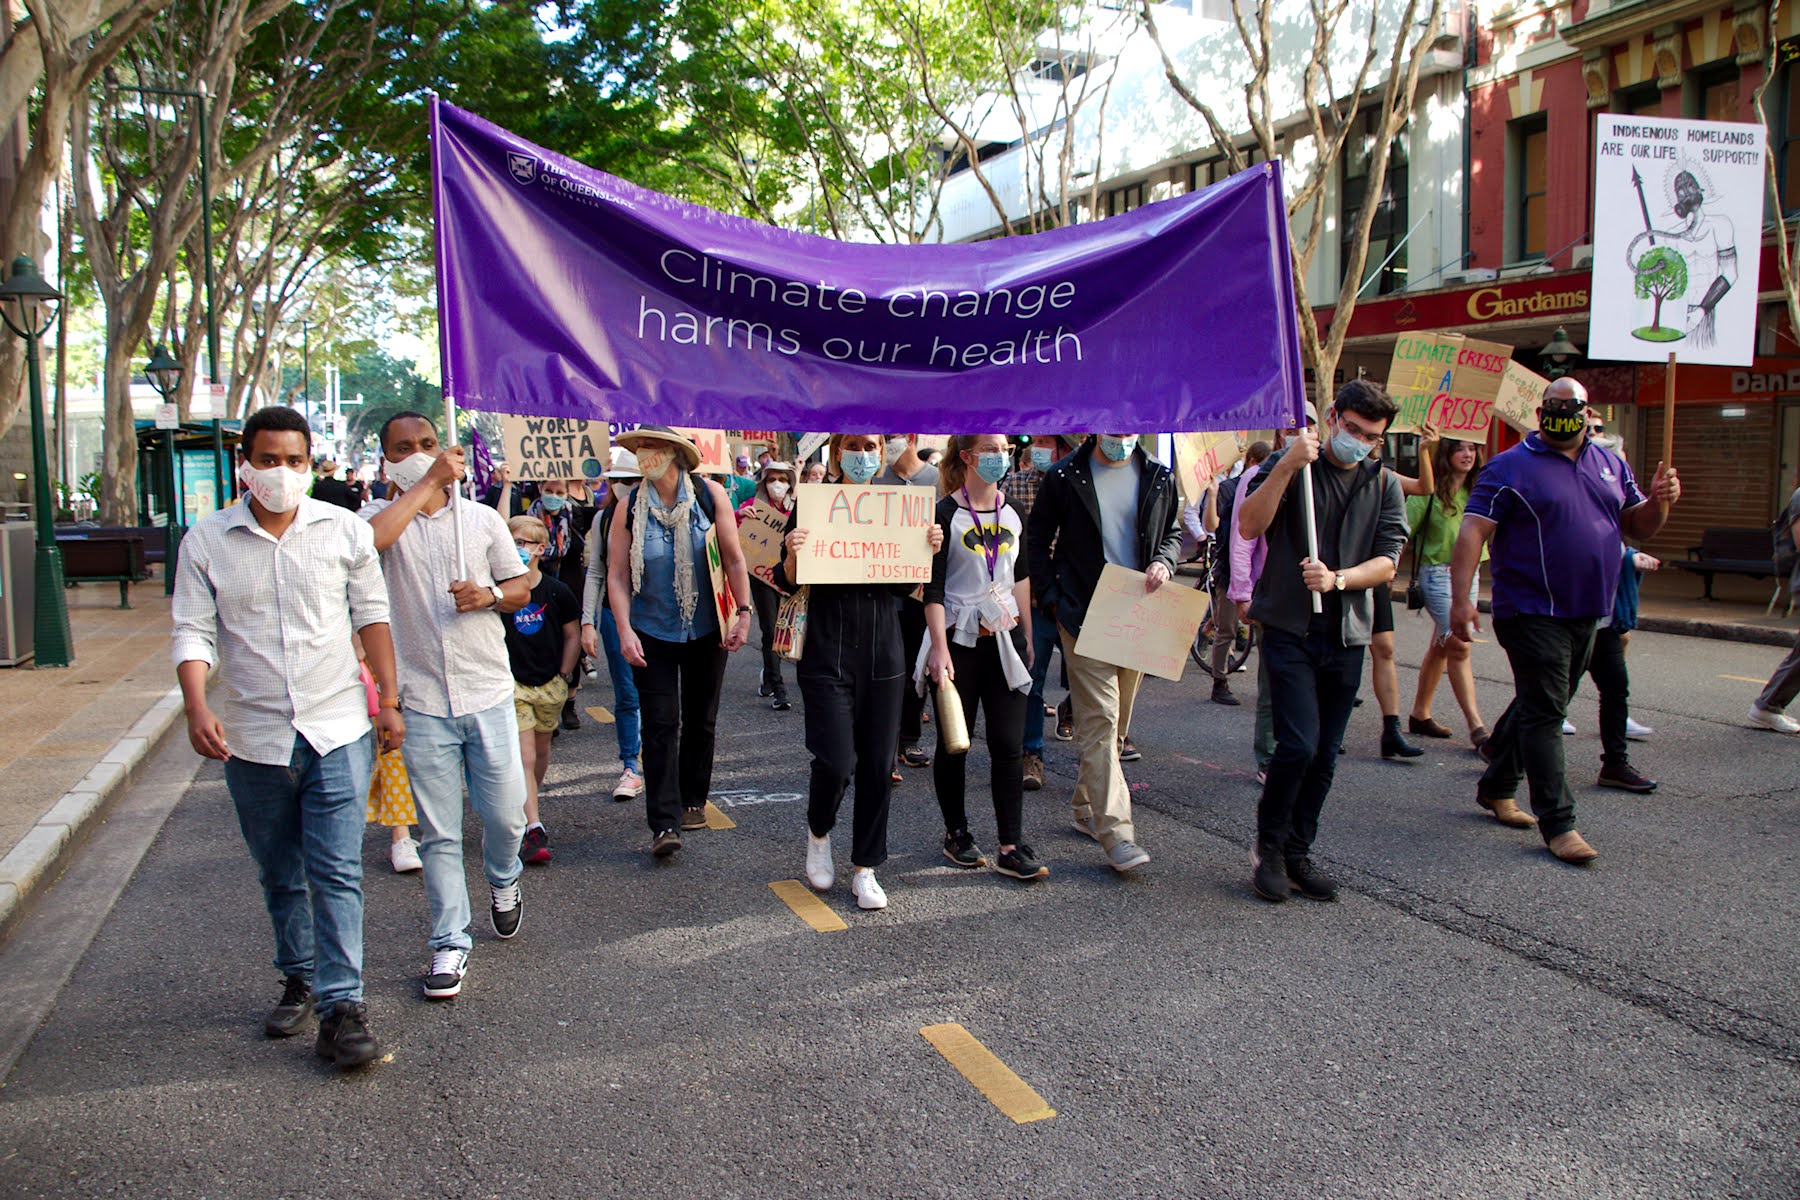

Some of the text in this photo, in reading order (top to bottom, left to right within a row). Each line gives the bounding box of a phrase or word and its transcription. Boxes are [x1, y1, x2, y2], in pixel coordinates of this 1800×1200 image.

[1612, 124, 1755, 146] INDIGENOUS HOMELANDS
[1600, 142, 1759, 166] ARE OUR LIFE SUPPORT!!
[540, 173, 558, 187] OF
[660, 249, 1077, 320] Climate change
[1466, 288, 1589, 321] Gardams
[638, 296, 1083, 367] harms our health
[1395, 338, 1507, 373] CLIMATE CRISIS
[1410, 365, 1452, 392] IS A
[1427, 393, 1493, 431] CRISIS
[526, 418, 590, 435] WORLD
[520, 434, 596, 459] GRETA
[519, 459, 574, 478] AGAIN
[828, 489, 933, 528] ACT NOW
[811, 539, 901, 560] #CLIMATE
[866, 563, 930, 580] JUSTICE
[515, 613, 543, 624] NASA
